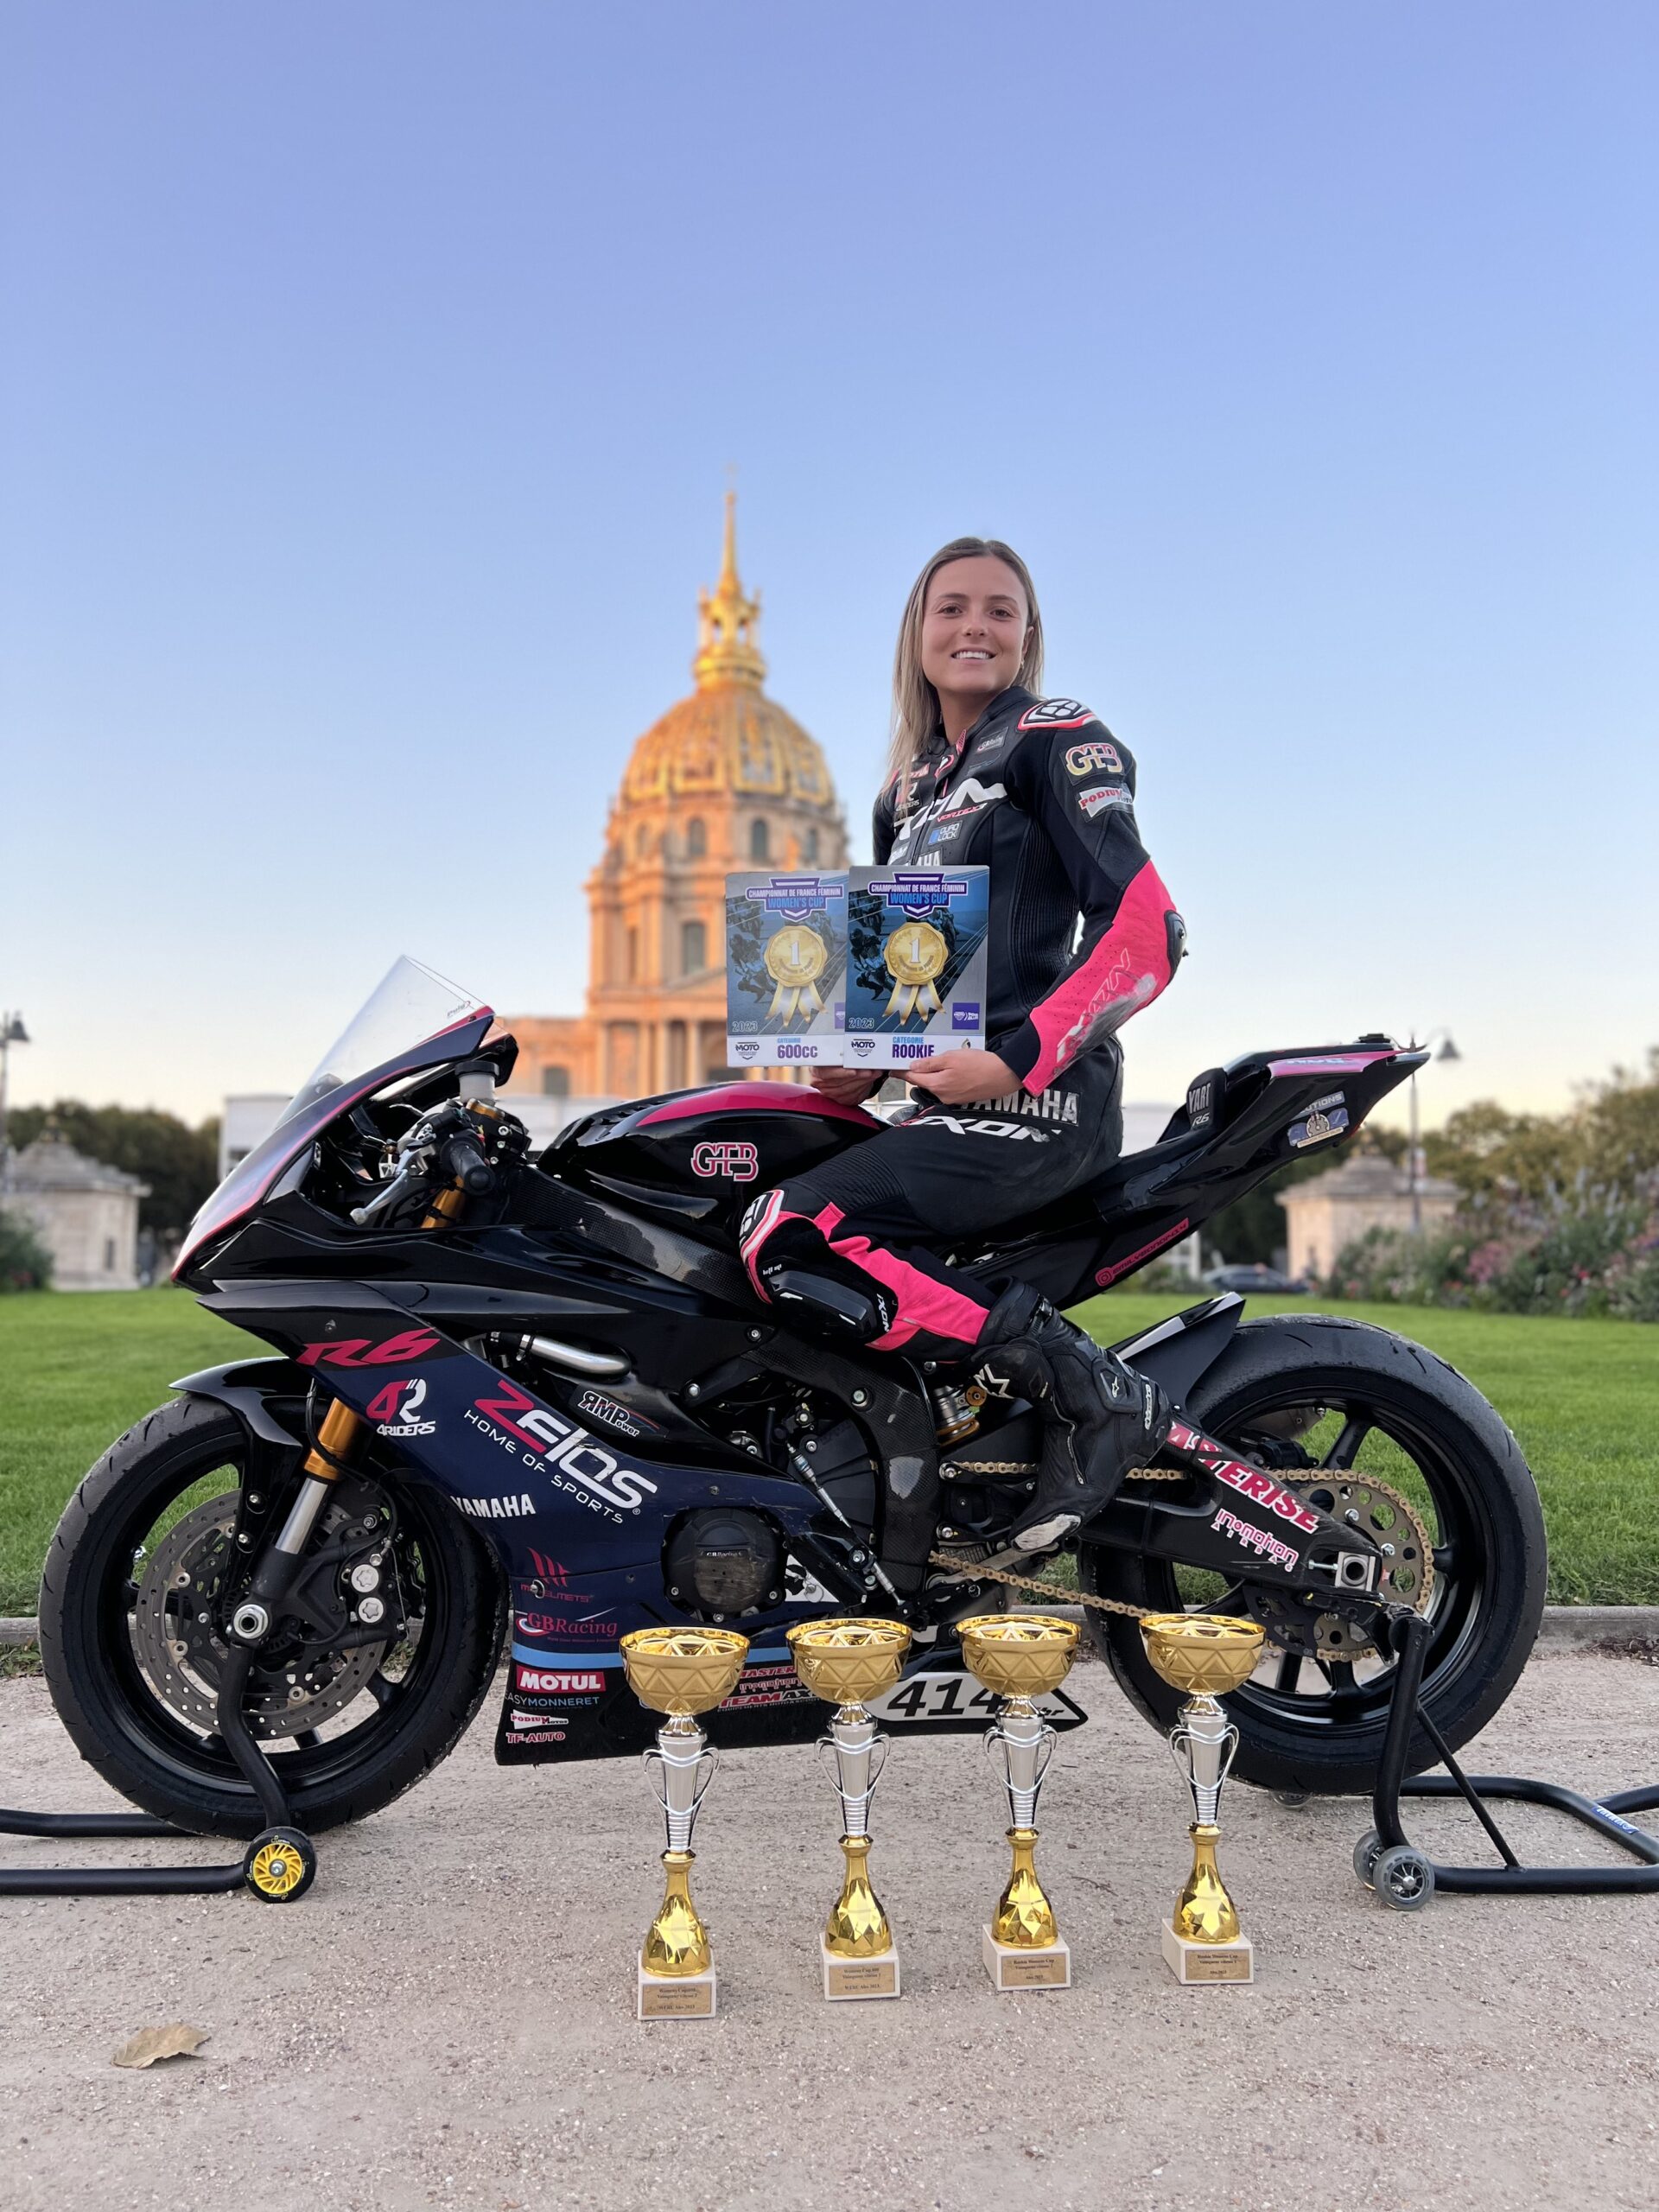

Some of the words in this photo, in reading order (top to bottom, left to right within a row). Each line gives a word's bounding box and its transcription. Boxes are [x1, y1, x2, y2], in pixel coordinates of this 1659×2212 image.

[1065, 743, 1122, 776] GTB
[748, 889, 788, 898] CHAMPIONNAT
[788, 888, 797, 897] DE
[817, 887, 841, 896] FÉMININ
[871, 883, 912, 893] CHAMPIONNAT
[912, 883, 919, 893] DE
[920, 883, 941, 893] FRANCE
[941, 881, 965, 893] FÉMININ
[767, 898, 805, 907] WOMEN'S
[807, 898, 824, 907] CUP
[890, 893, 929, 905] WOMEN'S
[930, 893, 948, 905] CUP
[790, 940, 800, 965] 1
[908, 938, 920, 963] 1
[732, 1020, 758, 1033] 2023
[849, 1018, 874, 1029] 2023
[892, 1045, 934, 1058] ROOKIE
[961, 1089, 1079, 1125] AMAHA
[691, 1141, 759, 1181] GTB
[296, 1327, 440, 1366] R6
[377, 1421, 435, 1436] 4RIDERS
[464, 1409, 517, 1453] HOME
[522, 1453, 546, 1472] OF
[551, 1474, 623, 1523] SPORTS
[450, 1493, 536, 1518] YAMAHA
[520, 1670, 601, 1690] MOTUL
[505, 1732, 566, 1744] TF-AUTO
